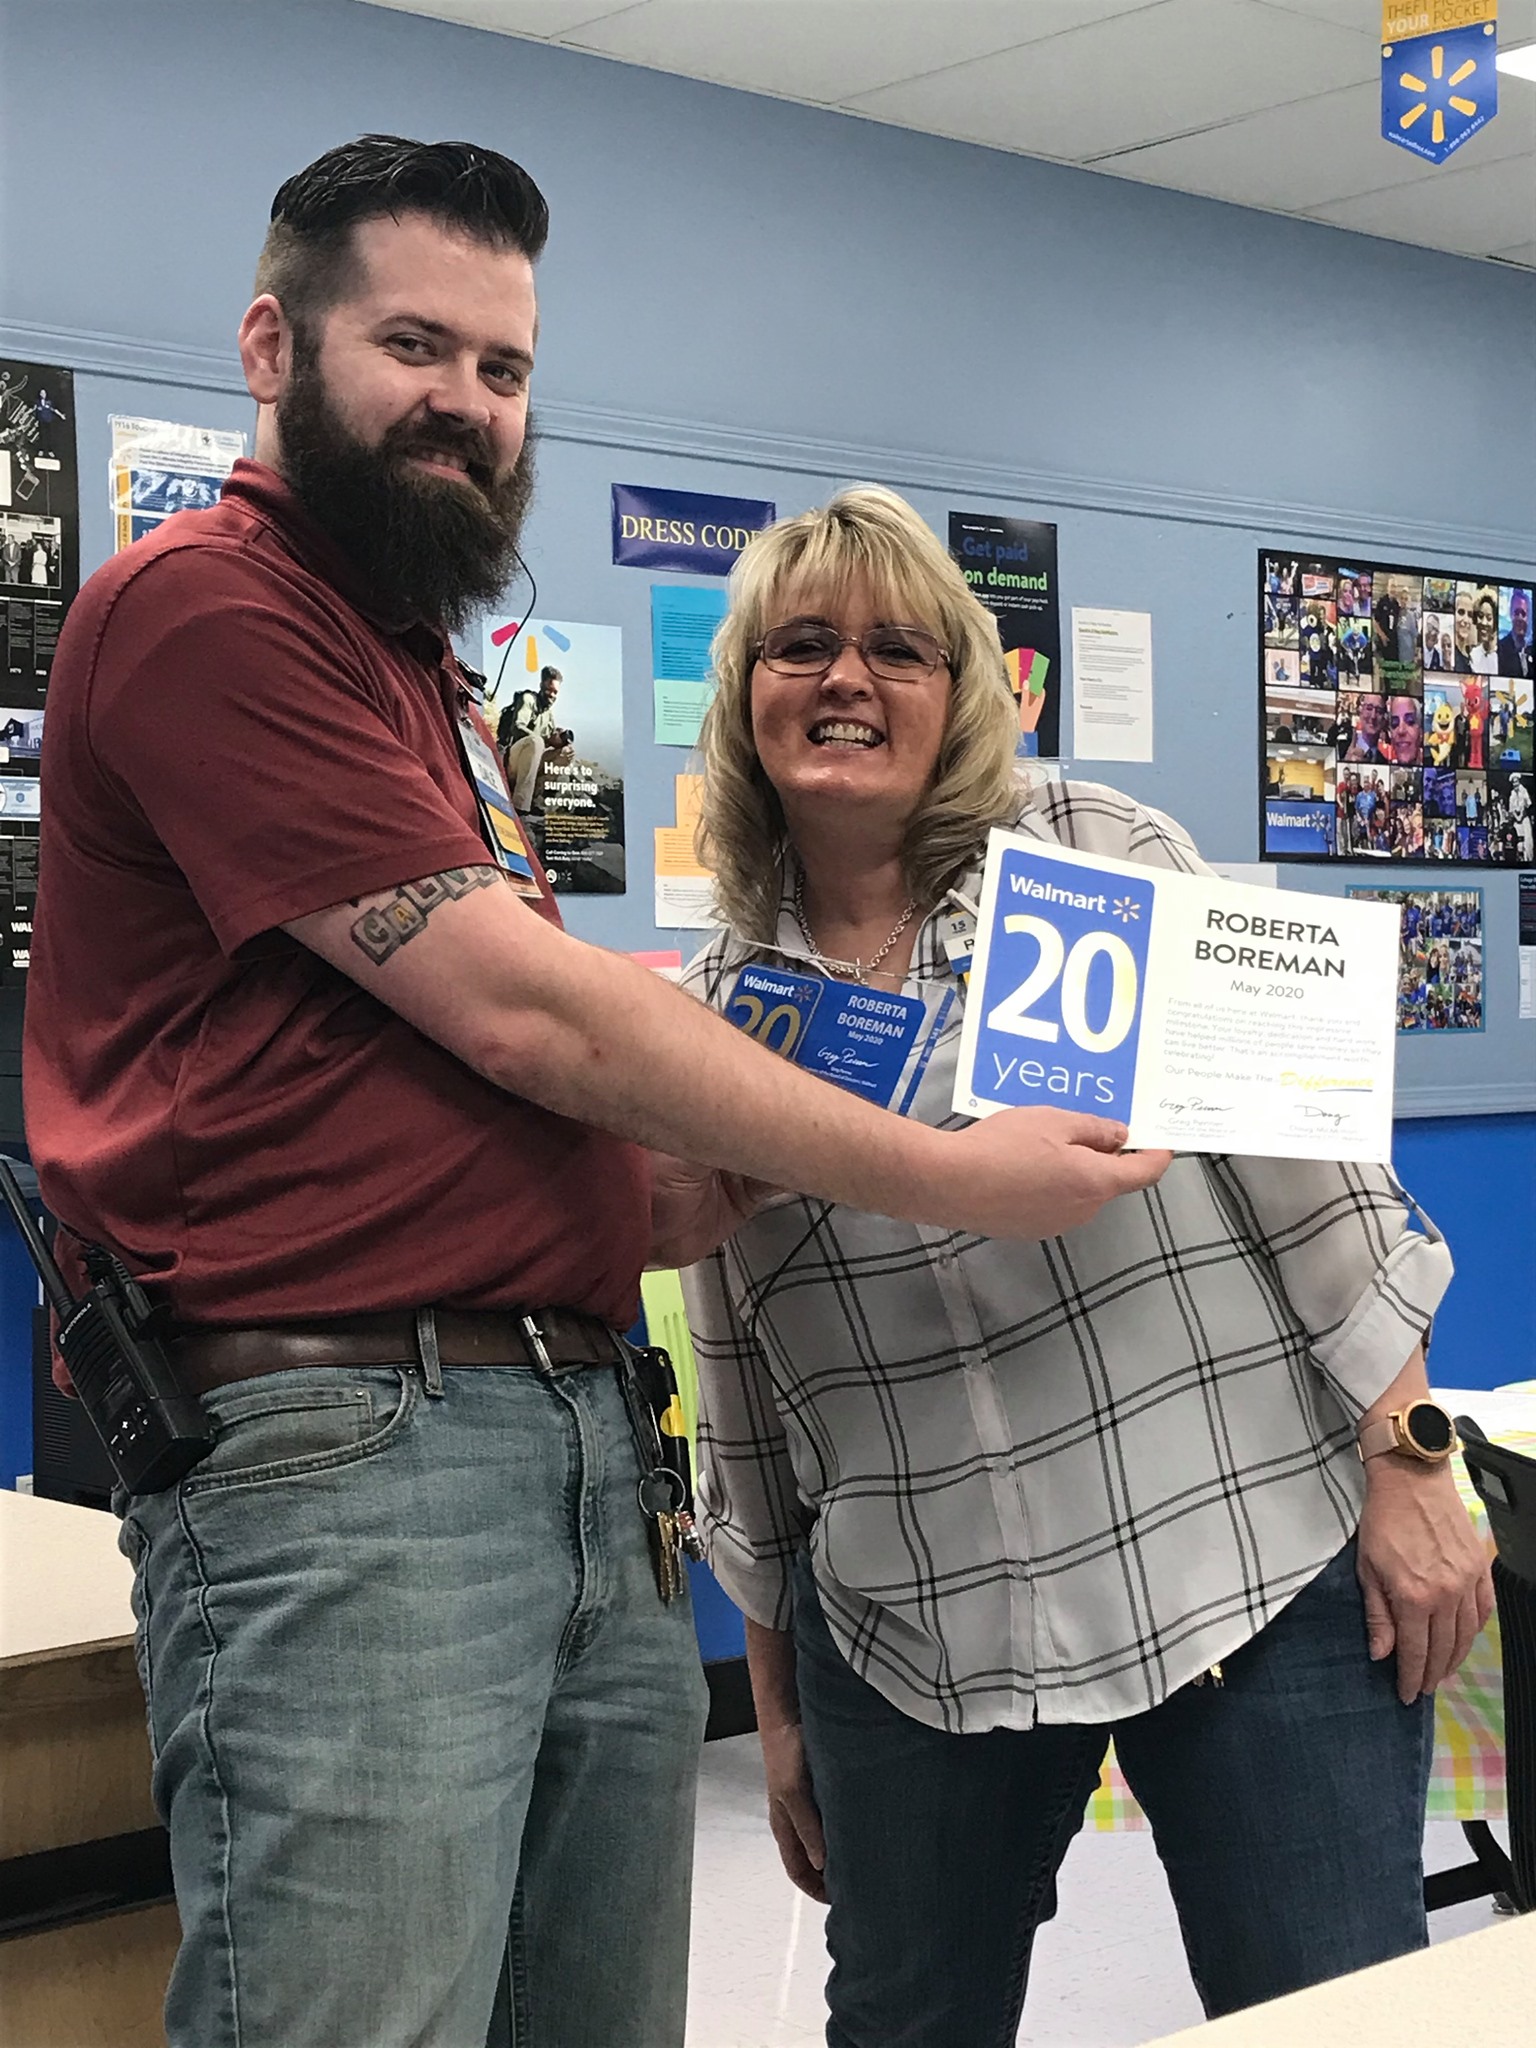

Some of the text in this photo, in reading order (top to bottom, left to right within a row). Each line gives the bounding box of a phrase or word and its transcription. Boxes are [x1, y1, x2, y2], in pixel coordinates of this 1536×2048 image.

[1386, 14, 1429, 34] YOUR
[1433, 0, 1490, 24] POCKET
[621, 515, 695, 546] DRESS
[962, 536, 1029, 565] Get paid
[963, 566, 1048, 591] on demand
[544, 761, 593, 777] Here's to
[544, 781, 598, 795] surprising
[544, 796, 597, 811] everyone.
[1266, 811, 1310, 828] Walmart
[1009, 873, 1107, 914] Walmart
[951, 920, 966, 931] 15
[1206, 909, 1340, 947] ROBERTA
[1195, 939, 1345, 978] BOREMAN
[744, 974, 795, 998] Walmart
[987, 914, 1138, 1053] 20
[1230, 980, 1304, 999] May 2020
[847, 995, 908, 1020] ROBERTA
[837, 1013, 905, 1039] BOREMAN
[847, 1030, 884, 1046] May 2020
[992, 1052, 1115, 1103] years
[1165, 1064, 1185, 1074] Our
[1188, 1067, 1222, 1079] People
[1225, 1071, 1251, 1081] Make
